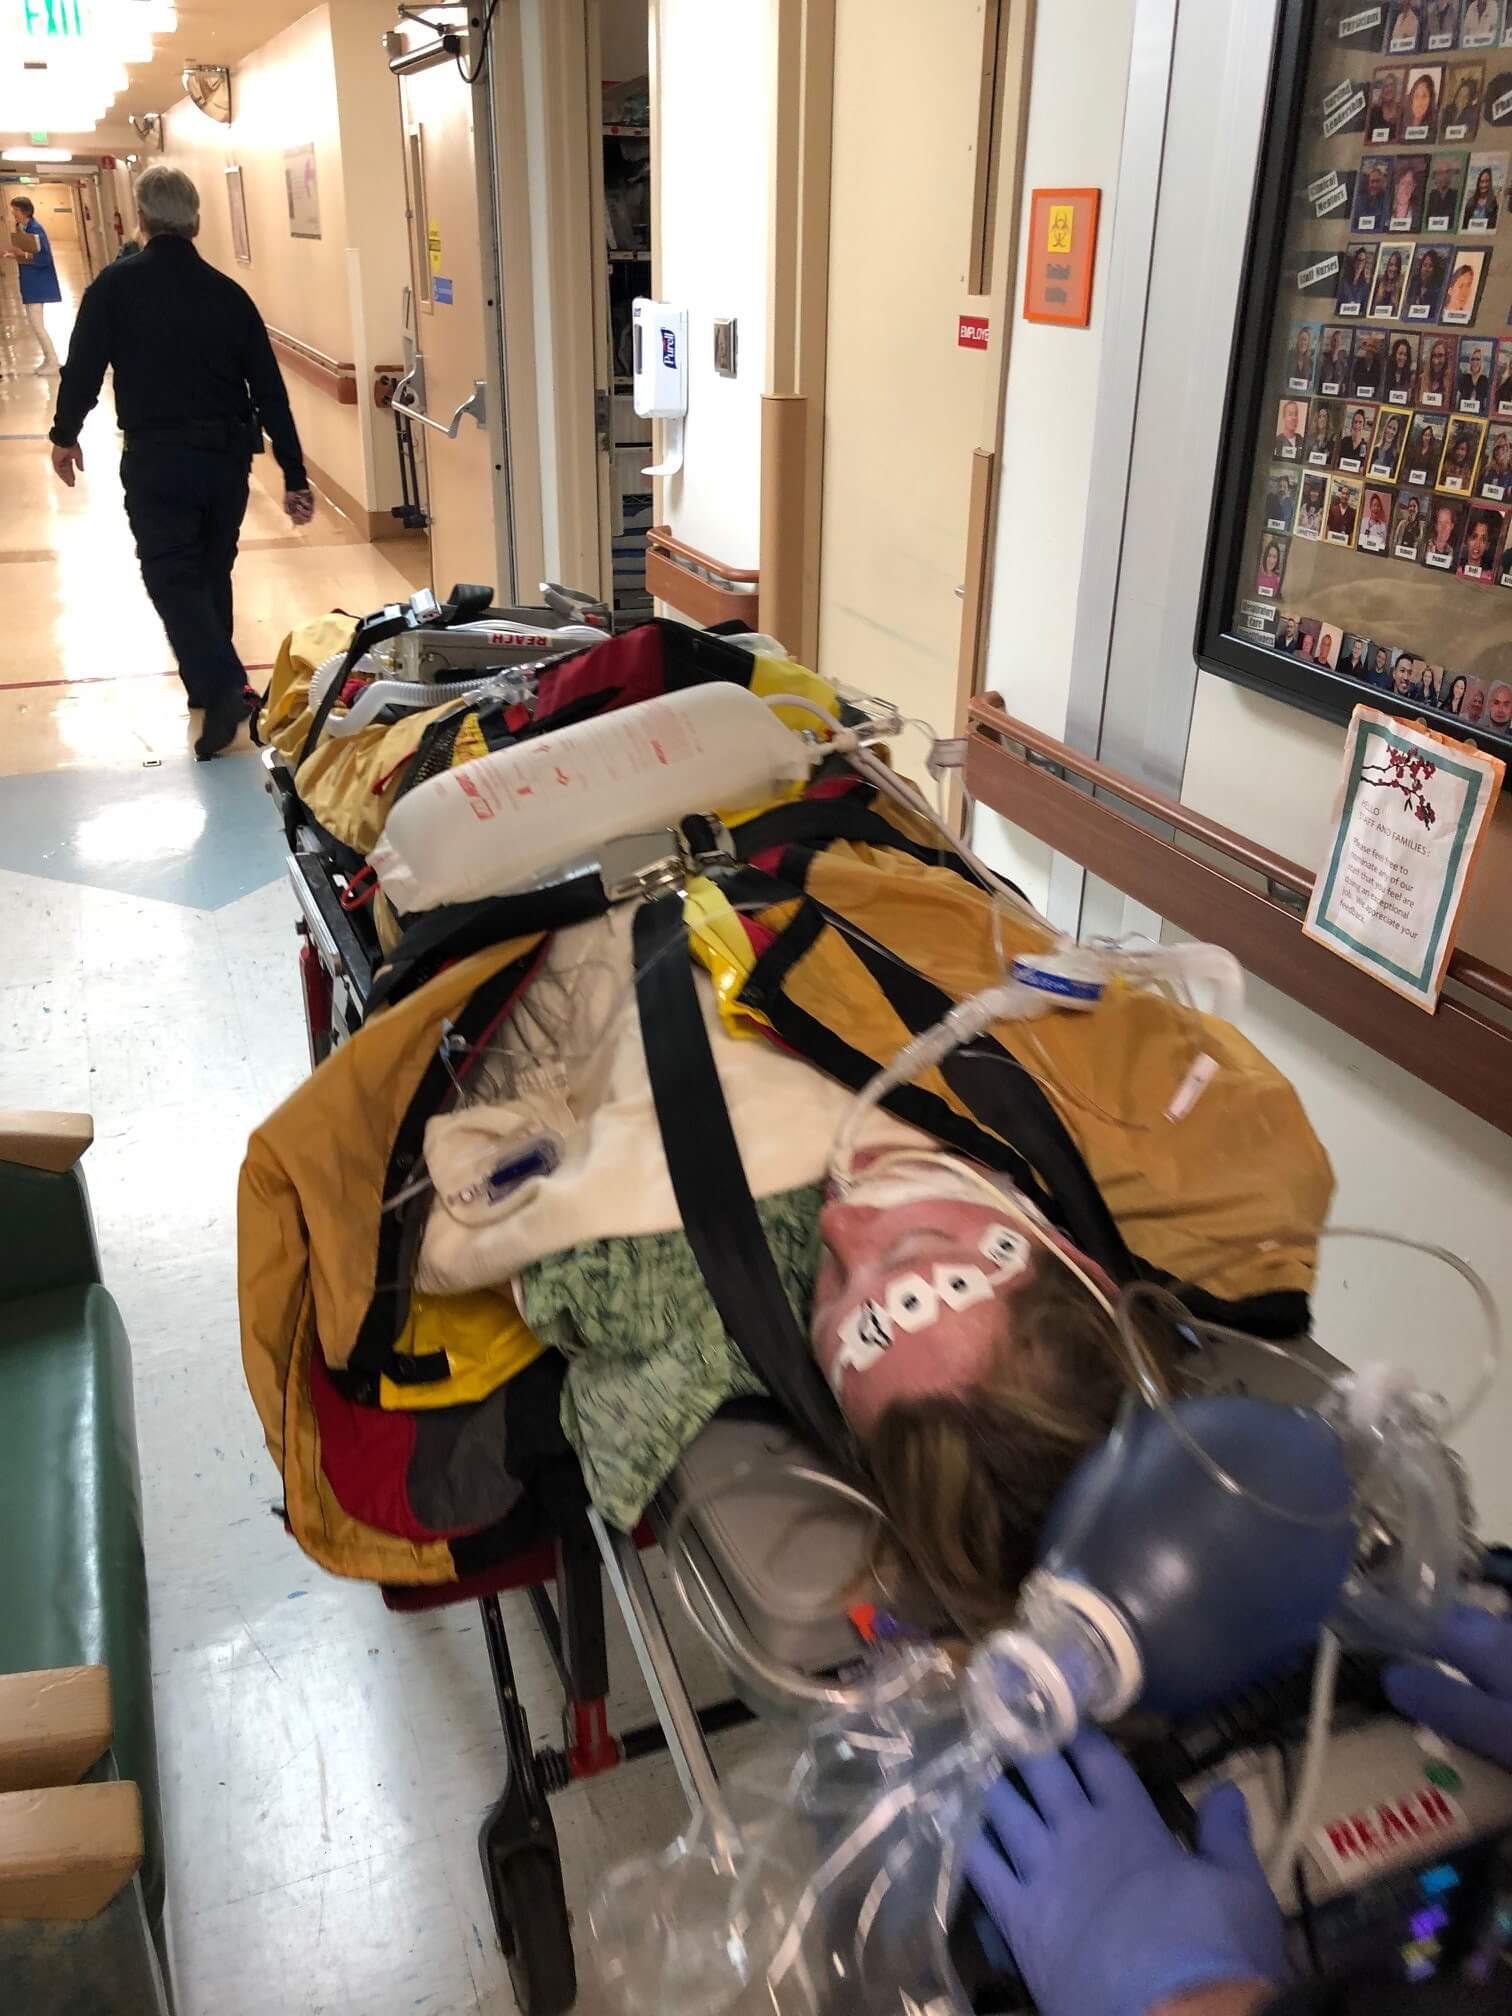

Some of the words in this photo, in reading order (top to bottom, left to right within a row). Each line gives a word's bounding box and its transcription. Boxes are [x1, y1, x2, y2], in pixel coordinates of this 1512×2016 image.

[493, 633, 546, 646] REACH
[1390, 876, 1400, 887] of
[1386, 887, 1402, 902] feel
[1370, 893, 1410, 921] eeptional
